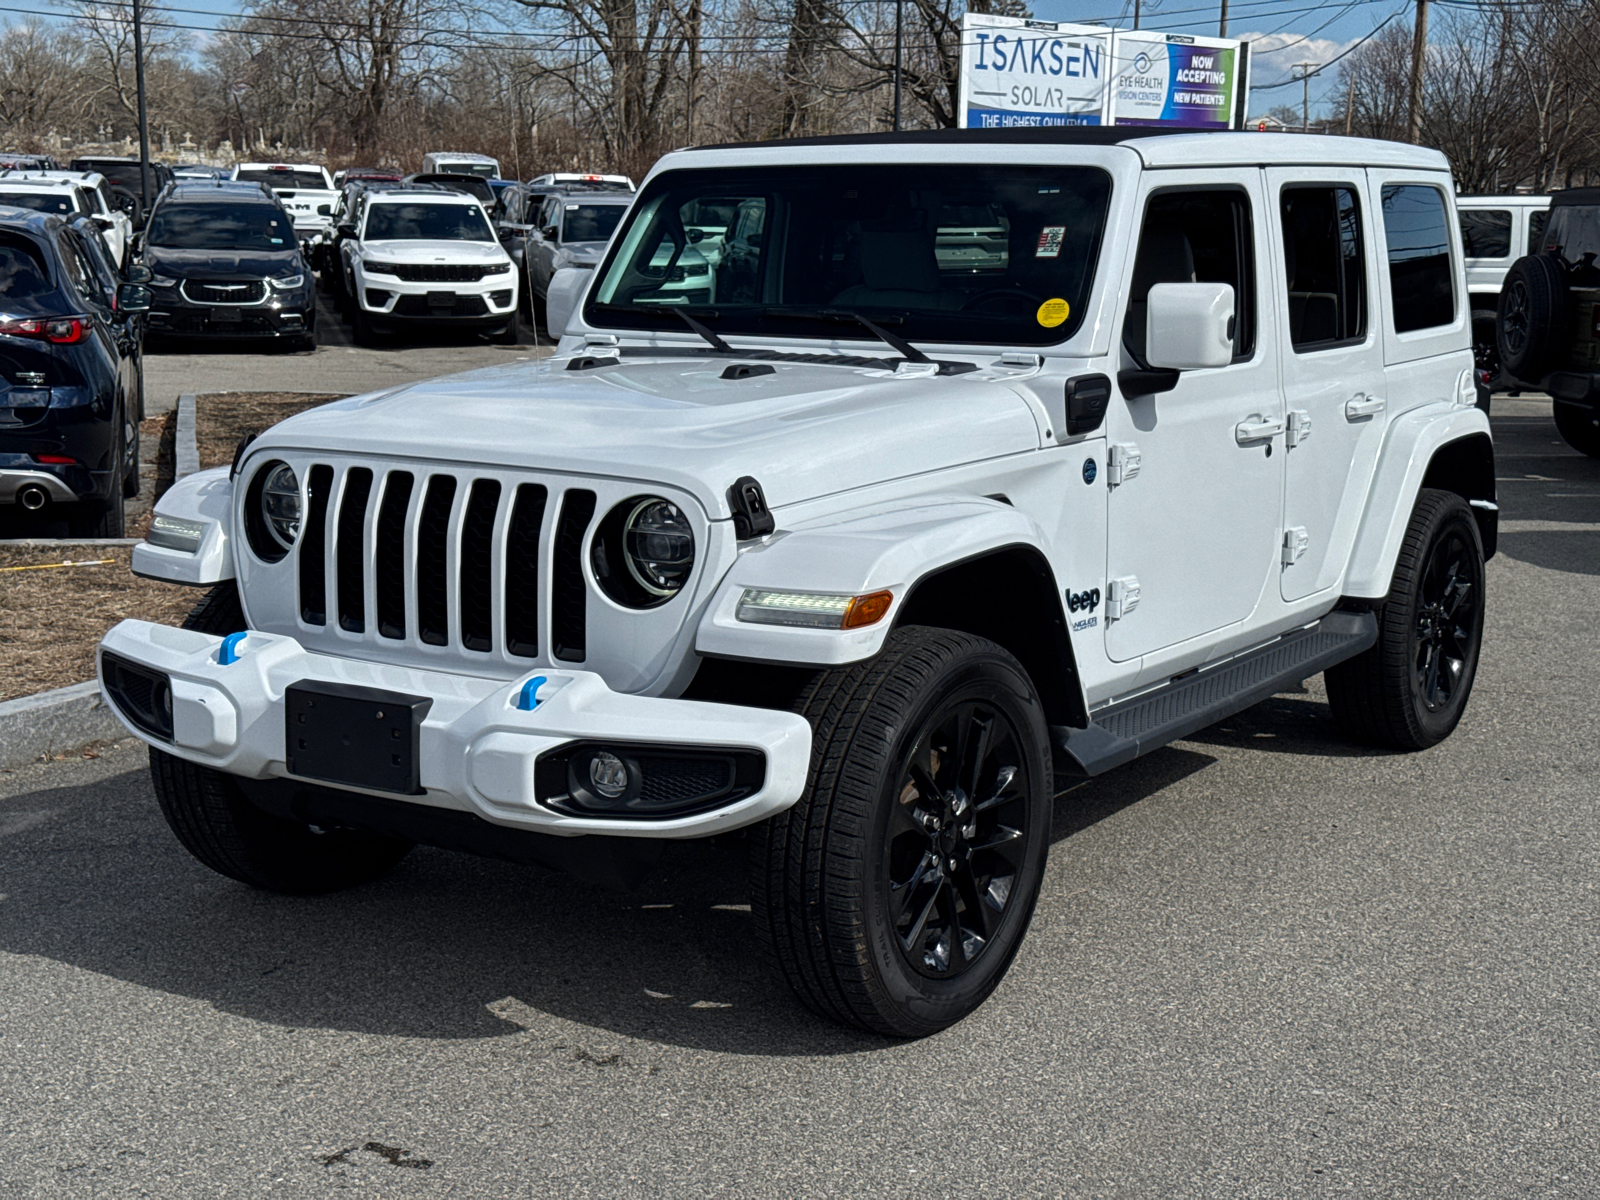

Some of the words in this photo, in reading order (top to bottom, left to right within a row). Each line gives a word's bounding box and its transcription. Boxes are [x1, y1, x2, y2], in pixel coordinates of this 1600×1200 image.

[975, 33, 1099, 79] ISAKSEN
[1191, 56, 1214, 69] NOW
[1119, 75, 1133, 87] EYE
[1134, 76, 1163, 89] HEALTH
[1176, 69, 1226, 85] ACCEPTING
[1011, 85, 1063, 107] SOLAR
[1118, 91, 1137, 100] VISION
[1138, 91, 1162, 101] CENTERS
[1173, 92, 1191, 103] NEW
[1191, 93, 1226, 105] PATIENTS!
[981, 114, 1000, 128] THE
[1002, 115, 1041, 127] HIGHEST
[1065, 588, 1100, 614] Jeep
